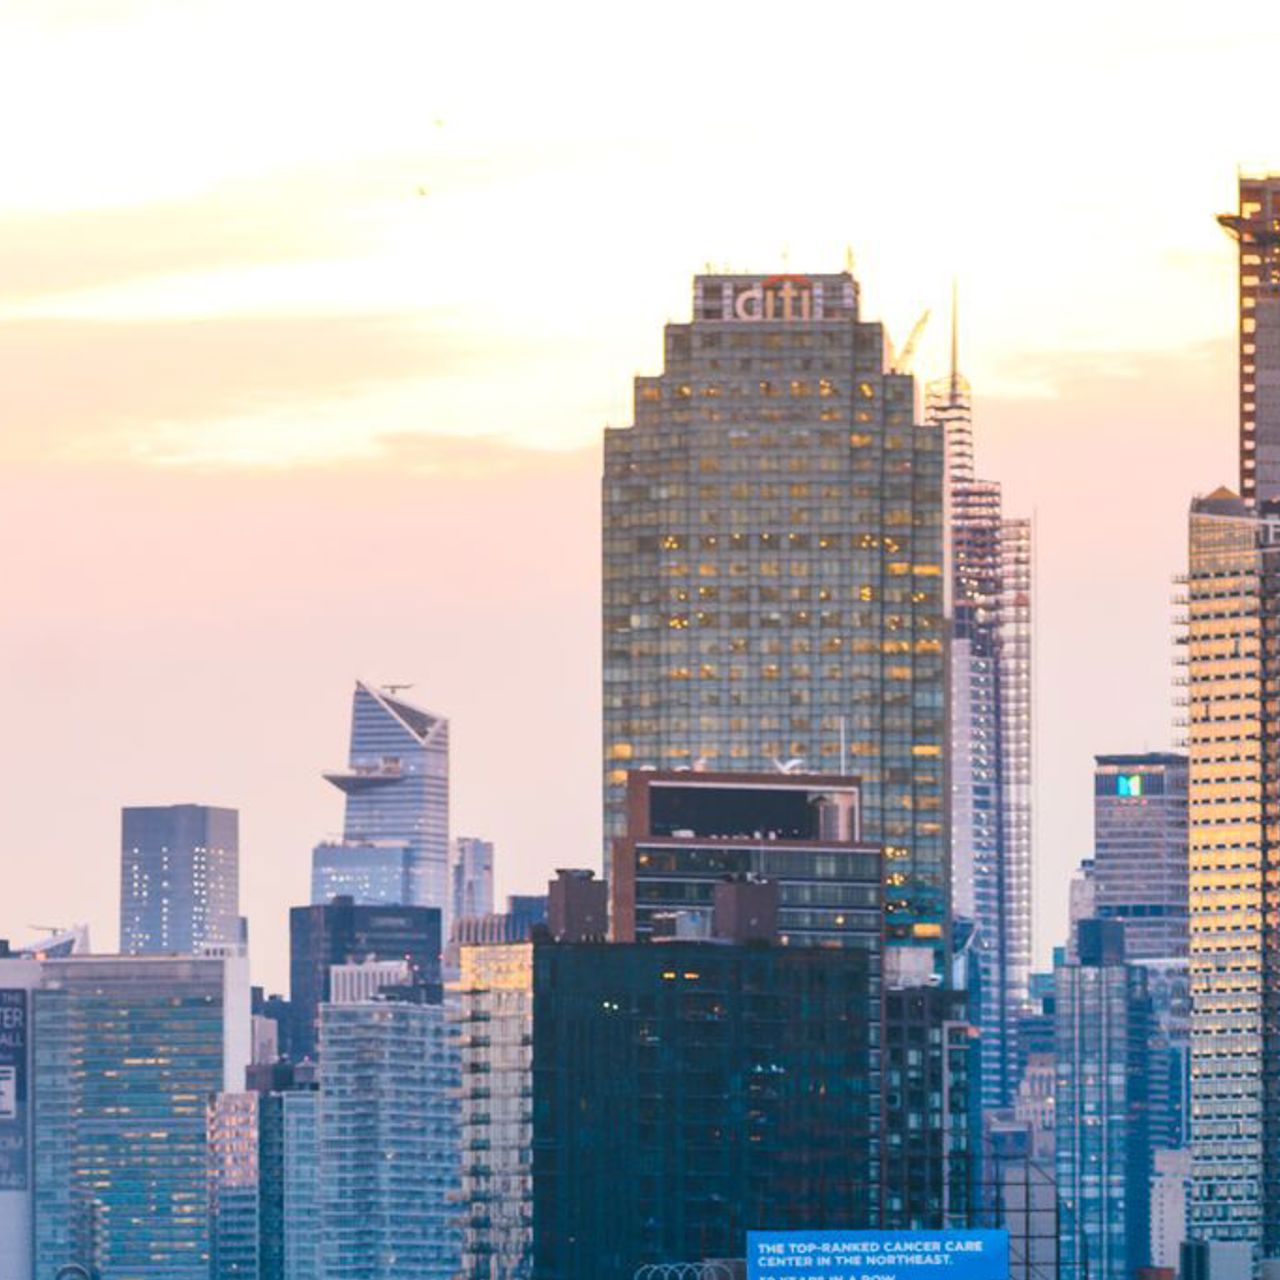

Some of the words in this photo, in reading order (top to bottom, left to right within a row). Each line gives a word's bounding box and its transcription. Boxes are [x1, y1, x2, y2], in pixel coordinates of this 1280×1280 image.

[735, 277, 810, 321] citi
[0, 1032, 23, 1047] ALL
[758, 1243, 784, 1254] THE
[789, 1241, 880, 1254] TOP-RANKED
[883, 1241, 941, 1253] CANCER
[945, 1241, 983, 1252] CARE
[758, 1256, 813, 1267] CENTER
[817, 1256, 831, 1266] IN
[835, 1255, 862, 1265] THE
[866, 1254, 954, 1265] NORTHEAST.
